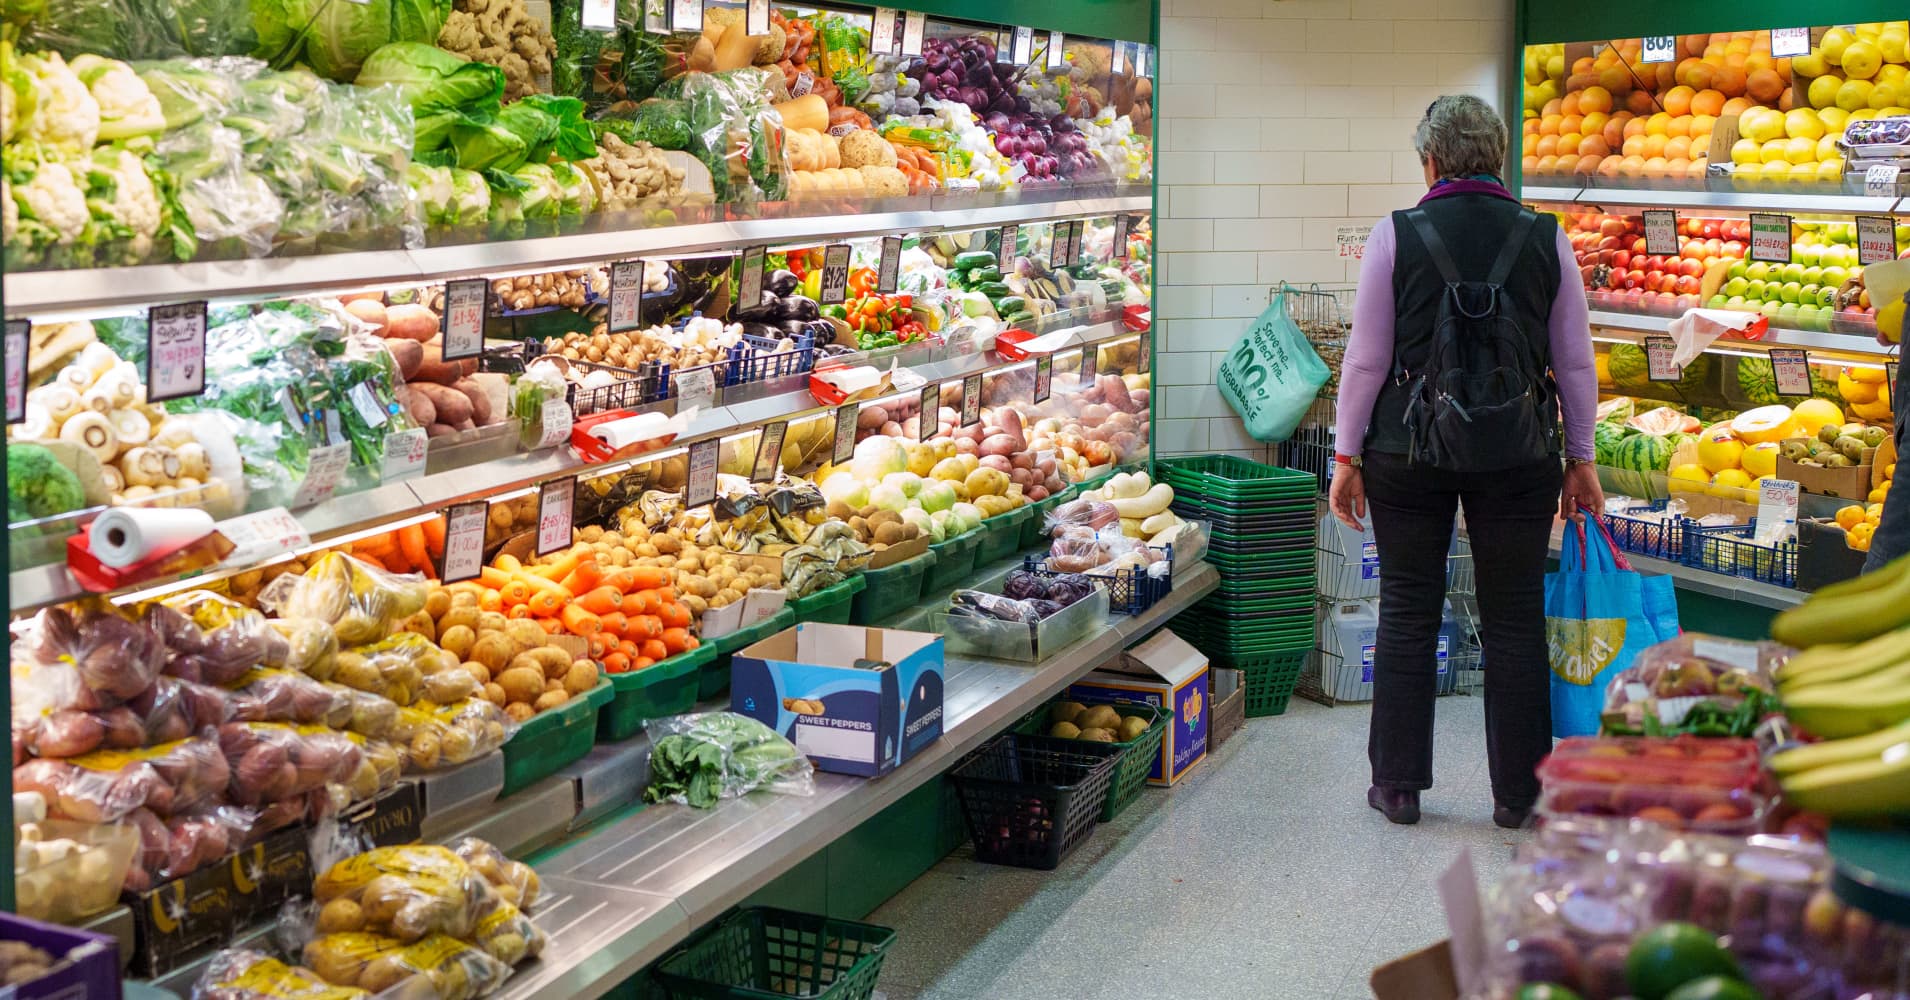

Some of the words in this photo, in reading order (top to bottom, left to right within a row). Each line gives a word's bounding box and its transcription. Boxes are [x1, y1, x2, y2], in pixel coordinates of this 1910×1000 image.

[1262, 321, 1280, 349] Save
[799, 715, 830, 727] SWEET
[831, 718, 873, 731] PEPPERS
[906, 719, 922, 737] SWEET
[922, 705, 942, 728] PEPPERS
